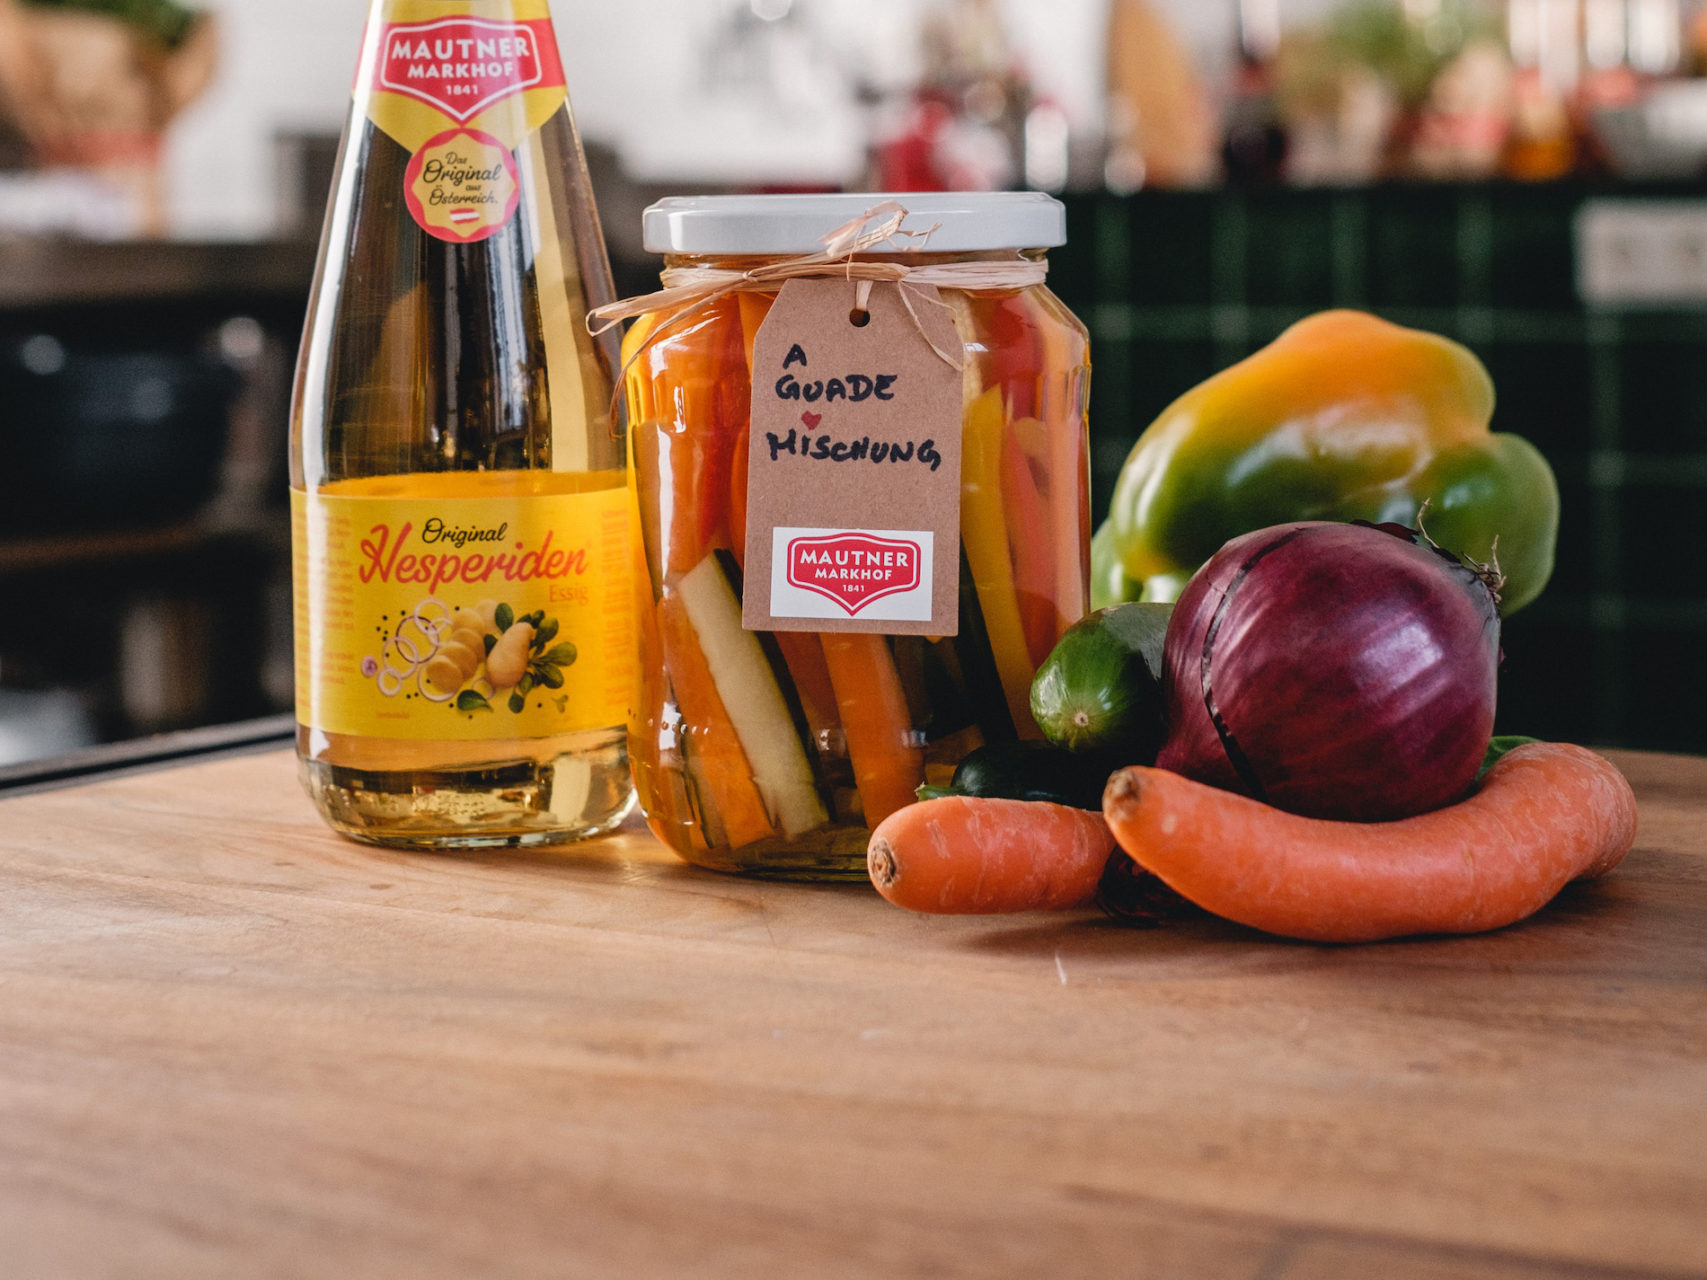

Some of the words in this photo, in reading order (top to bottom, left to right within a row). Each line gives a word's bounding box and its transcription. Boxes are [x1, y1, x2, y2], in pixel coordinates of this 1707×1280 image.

[391, 37, 530, 60] MAUTNER
[407, 61, 514, 78] MARKHOF
[445, 84, 479, 95] 1841
[445, 151, 467, 165] Das
[422, 159, 502, 186] Original
[465, 183, 482, 191] aus
[782, 343, 808, 369] A
[775, 374, 898, 402] GUADE
[766, 428, 942, 472] MISCHUNG
[421, 517, 508, 548] Original
[359, 522, 588, 595] Hesperiden
[800, 549, 909, 568] MAUTNER
[814, 567, 893, 581] MARKHOF
[549, 584, 589, 605] Essig
[842, 584, 866, 593] 1841
